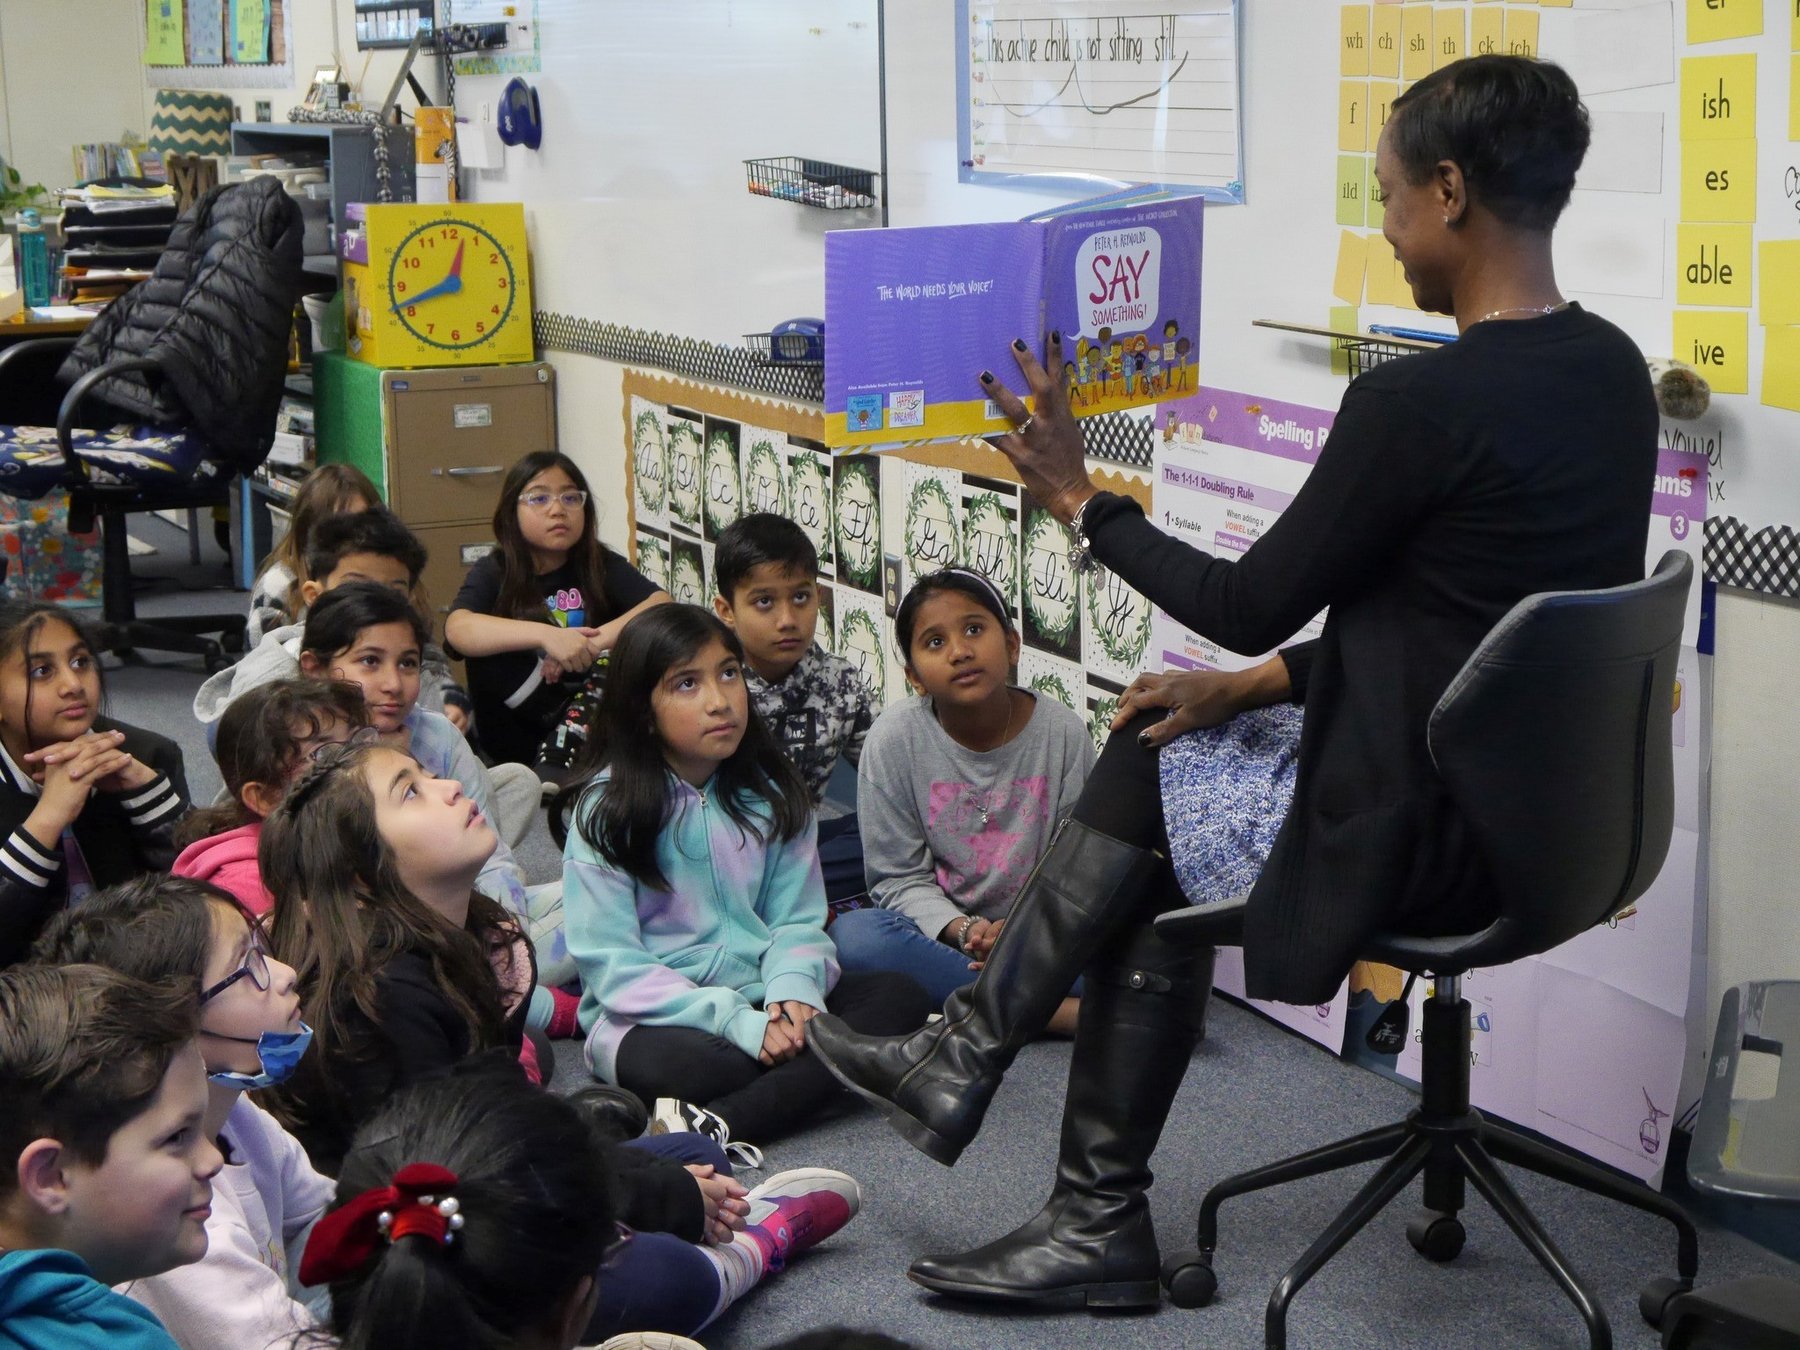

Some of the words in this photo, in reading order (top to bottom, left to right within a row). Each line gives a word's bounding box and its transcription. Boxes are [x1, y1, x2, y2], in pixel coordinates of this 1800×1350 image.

[1007, 20, 1037, 62] active
[1045, 19, 1070, 62] child
[1086, 18, 1102, 61] not
[1109, 17, 1143, 64] sitting
[1346, 32, 1363, 49] wh
[1379, 33, 1393, 50] ch
[1410, 34, 1425, 52] sh
[1443, 37, 1456, 55] th
[1479, 36, 1494, 53] ck
[1510, 40, 1531, 56] tch
[1703, 78, 1730, 118] ish
[1350, 102, 1357, 124] f
[1706, 168, 1729, 191] es
[1343, 183, 1358, 199] ild
[419, 237, 435, 249] 11
[441, 229, 459, 240] 12
[472, 236, 479, 247] 1
[1094, 236, 1112, 251] PETER
[1120, 231, 1147, 248] REYNOLDS
[403, 257, 421, 269] 10
[490, 254, 499, 265] 2
[1687, 245, 1732, 286] able
[498, 278, 508, 289] 3
[1089, 250, 1150, 304] SAY
[397, 281, 407, 293] 9
[877, 285, 893, 300] THE
[896, 284, 921, 300] WORLD
[922, 283, 946, 298] NEEDS
[948, 281, 967, 299] YOUR
[968, 279, 994, 294] VOICE!
[407, 306, 417, 318] 8
[491, 305, 500, 316] 4
[1091, 304, 1147, 326] SOMETHING!
[427, 324, 435, 335] 7
[451, 330, 460, 341] 6
[476, 322, 485, 333] 5
[1694, 339, 1725, 366] ive
[1259, 415, 1315, 450] Spelling
[710, 464, 734, 504] Cc
[1165, 468, 1179, 483] The
[1181, 472, 1199, 488] 1-1-1
[1201, 477, 1235, 498] Doubling
[1237, 486, 1255, 501] Rule
[801, 485, 820, 528] Ee
[1164, 511, 1170, 527] 1
[1175, 516, 1201, 533] Syllable
[1227, 508, 1242, 520] When
[1242, 514, 1259, 527] adding
[1675, 516, 1685, 535] 3
[1225, 521, 1246, 534] VOWEL
[1184, 646, 1203, 659] VOWEL
[1185, 634, 1199, 645] When
[1199, 640, 1216, 653] adding
